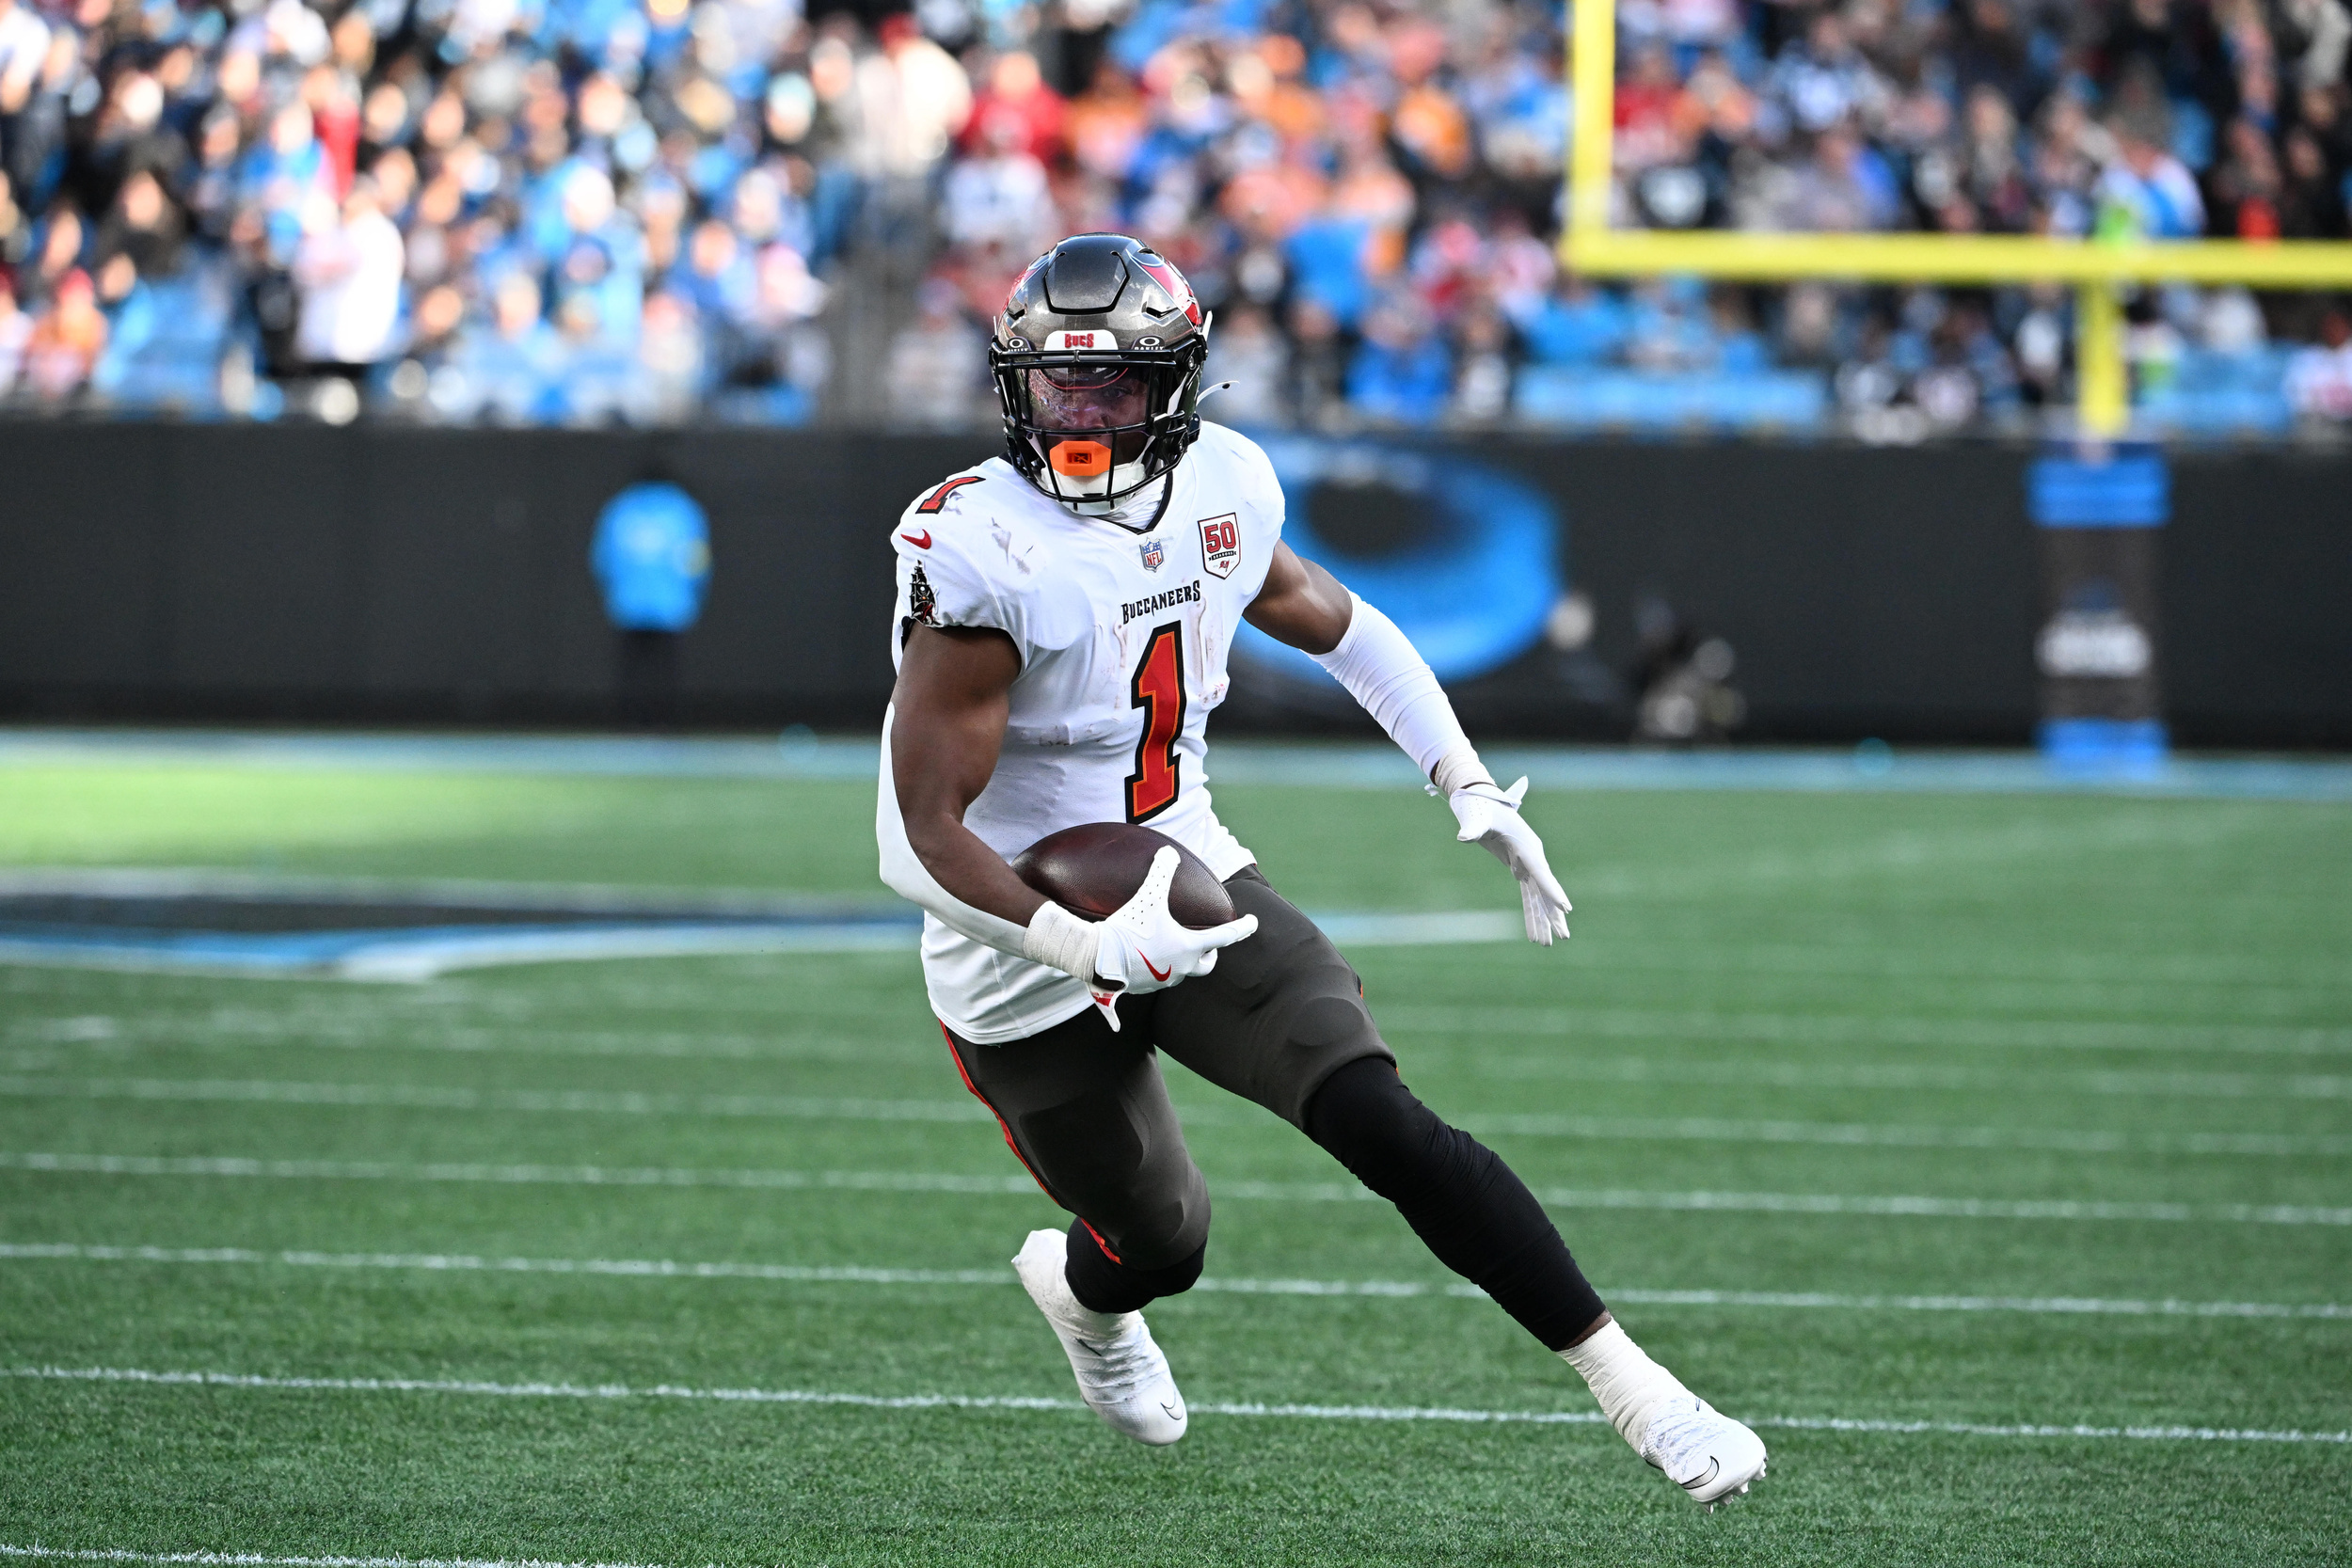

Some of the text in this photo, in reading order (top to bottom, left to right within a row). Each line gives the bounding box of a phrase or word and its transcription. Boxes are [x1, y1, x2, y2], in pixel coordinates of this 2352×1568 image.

[1064, 333, 1094, 348] BUCS
[915, 476, 986, 515] 1
[1204, 521, 1236, 554] 50
[1146, 551, 1162, 565] NFL
[1121, 579, 1201, 625] BUCCANEERS
[1124, 620, 1185, 823] 1
